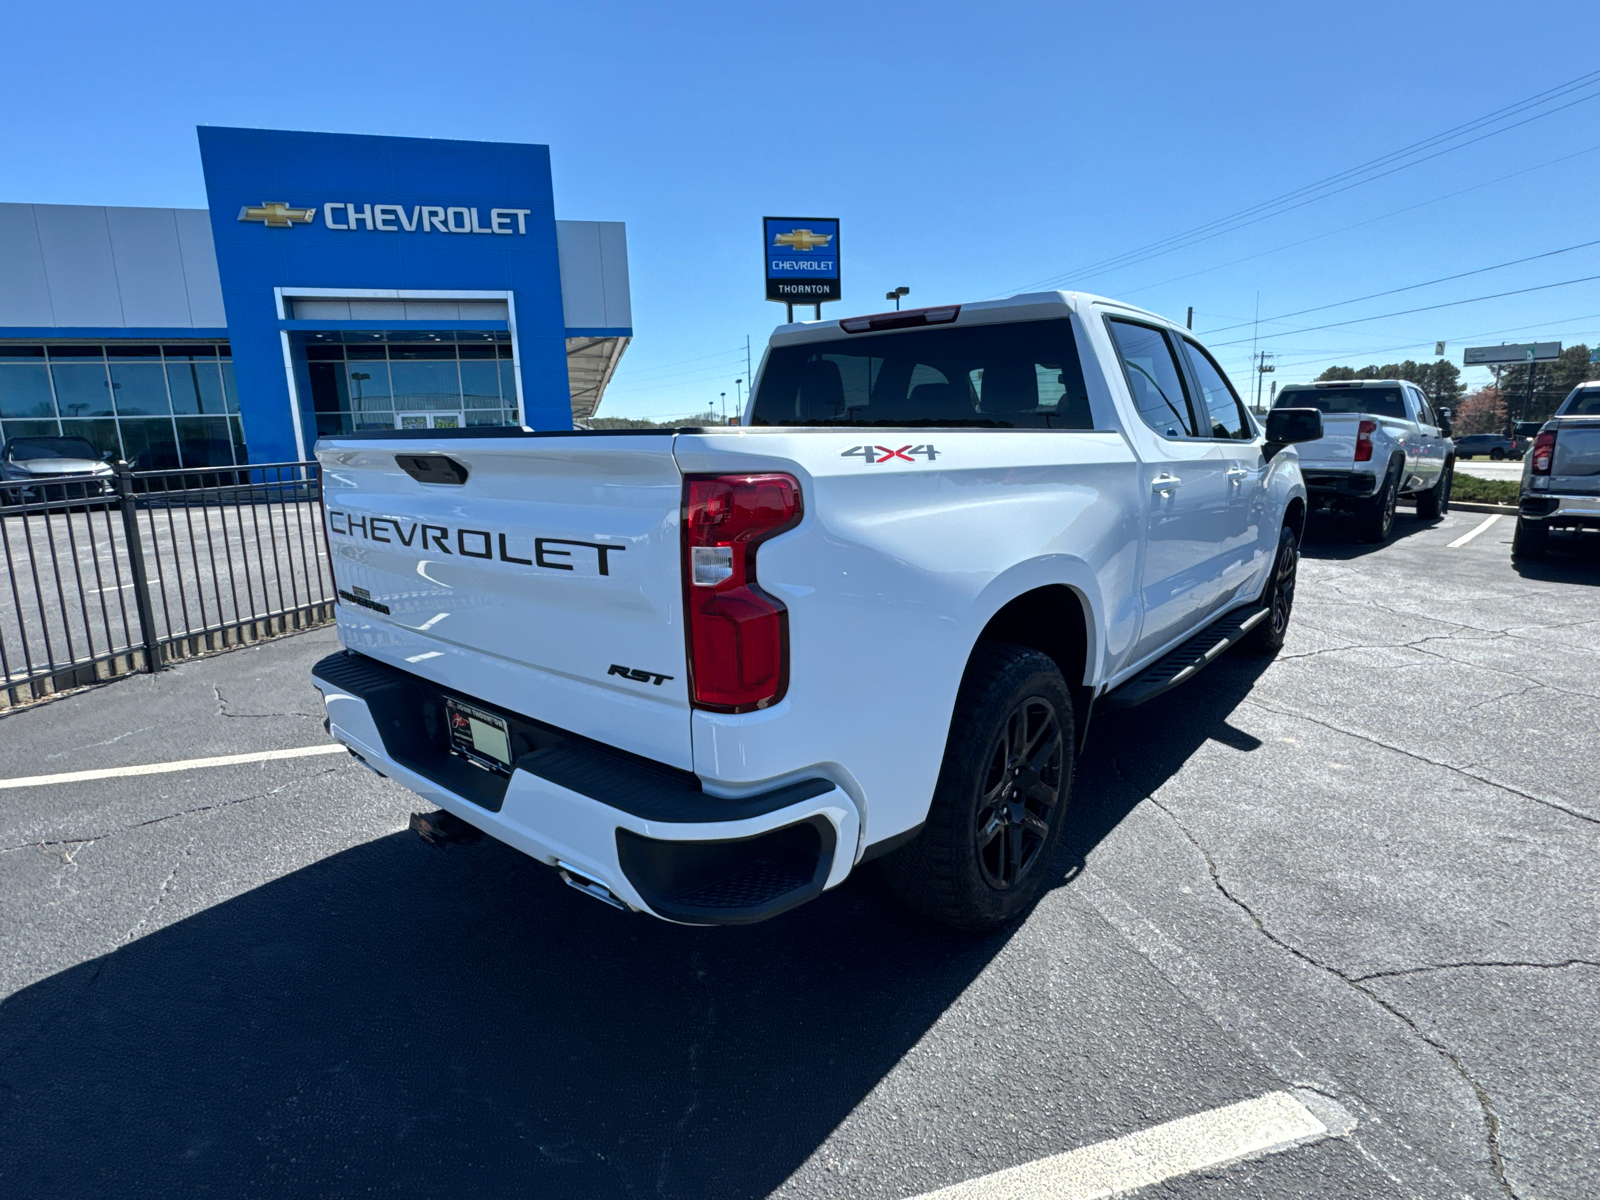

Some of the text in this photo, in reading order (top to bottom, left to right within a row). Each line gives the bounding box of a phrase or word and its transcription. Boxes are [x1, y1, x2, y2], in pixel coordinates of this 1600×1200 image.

[323, 202, 531, 235] CHEVROLET
[772, 260, 834, 271] CHEVROLET
[778, 284, 830, 294] THORNTON
[329, 510, 626, 577] CHEVROLET
[607, 663, 675, 686] RST
